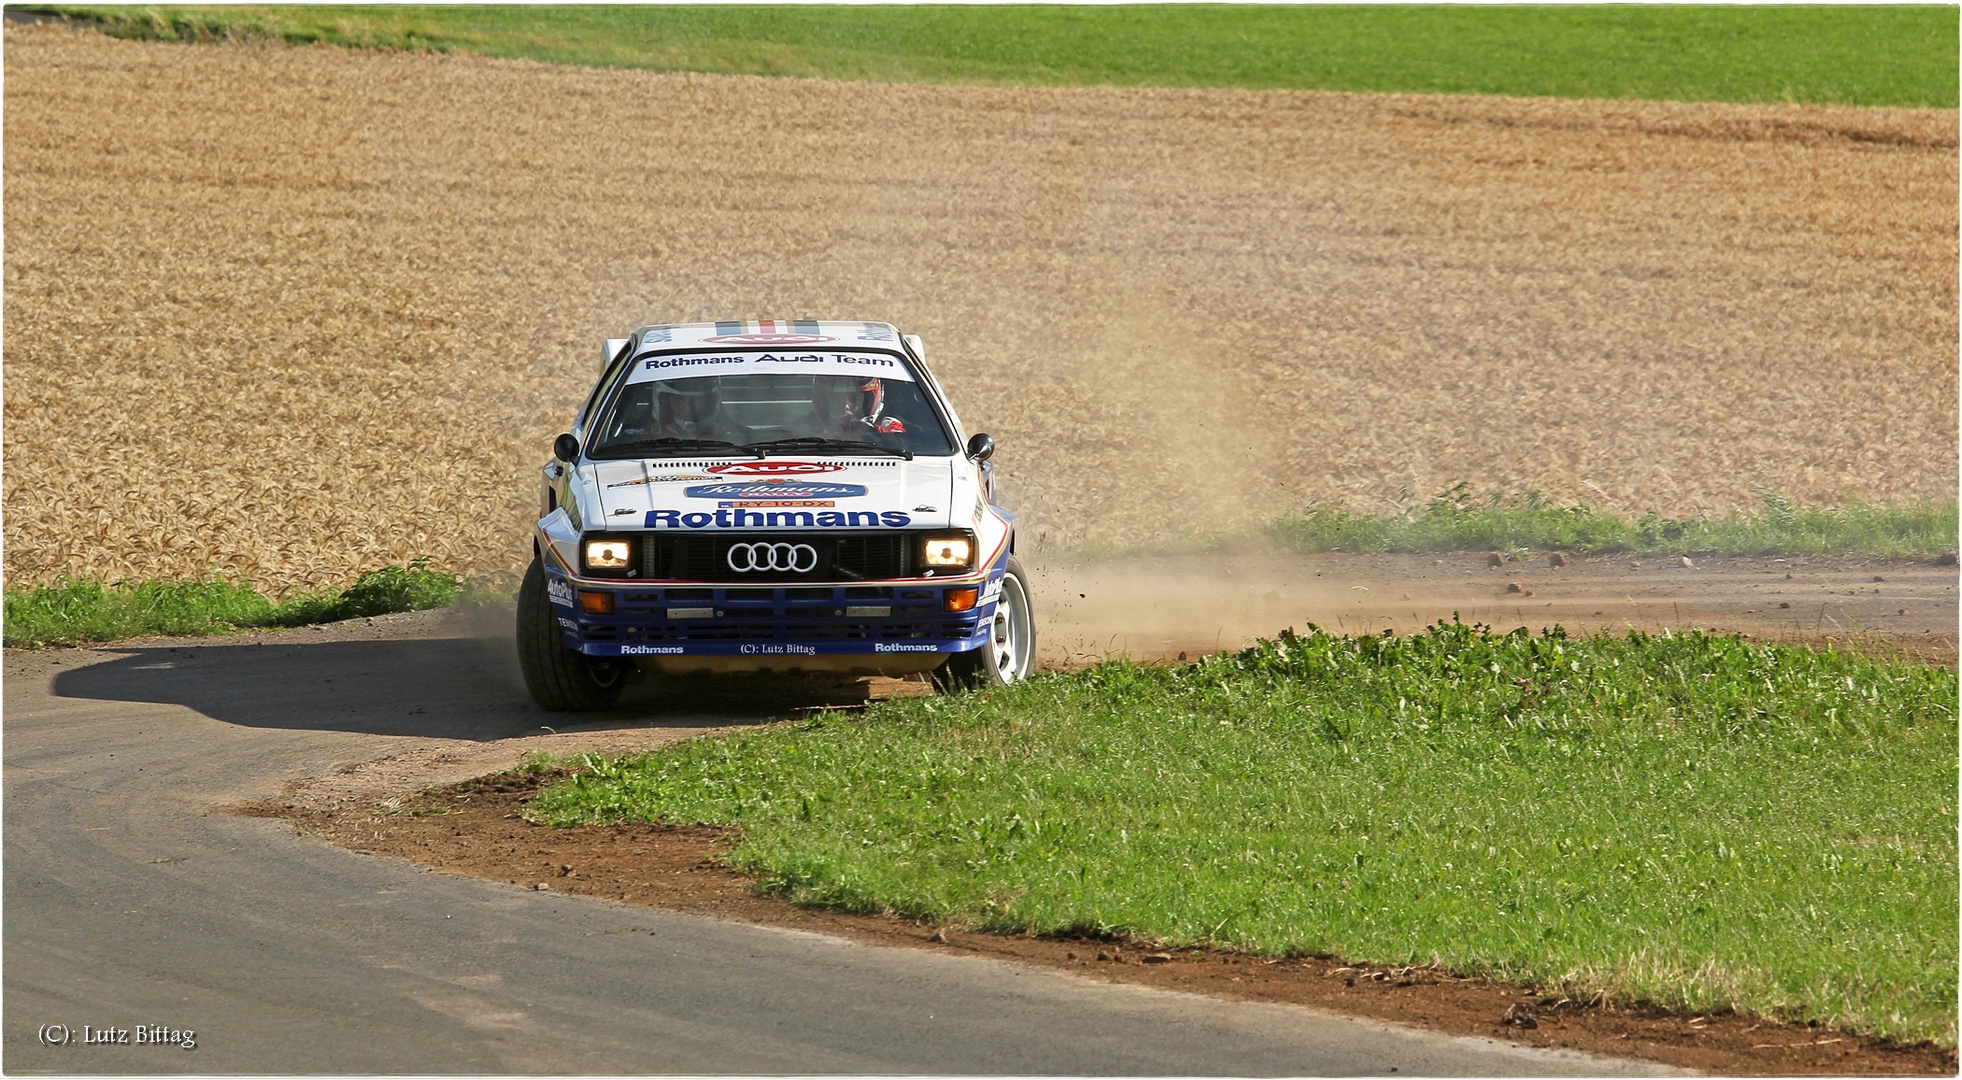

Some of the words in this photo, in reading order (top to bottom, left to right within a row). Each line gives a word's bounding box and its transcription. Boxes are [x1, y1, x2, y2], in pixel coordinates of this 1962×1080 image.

[645, 356, 745, 370] Rothmans
[831, 354, 894, 367] Team
[698, 484, 855, 494] Rothmans
[644, 508, 911, 529] Rothmans
[621, 645, 684, 655] Rothmans
[874, 643, 938, 652] Rothmans
